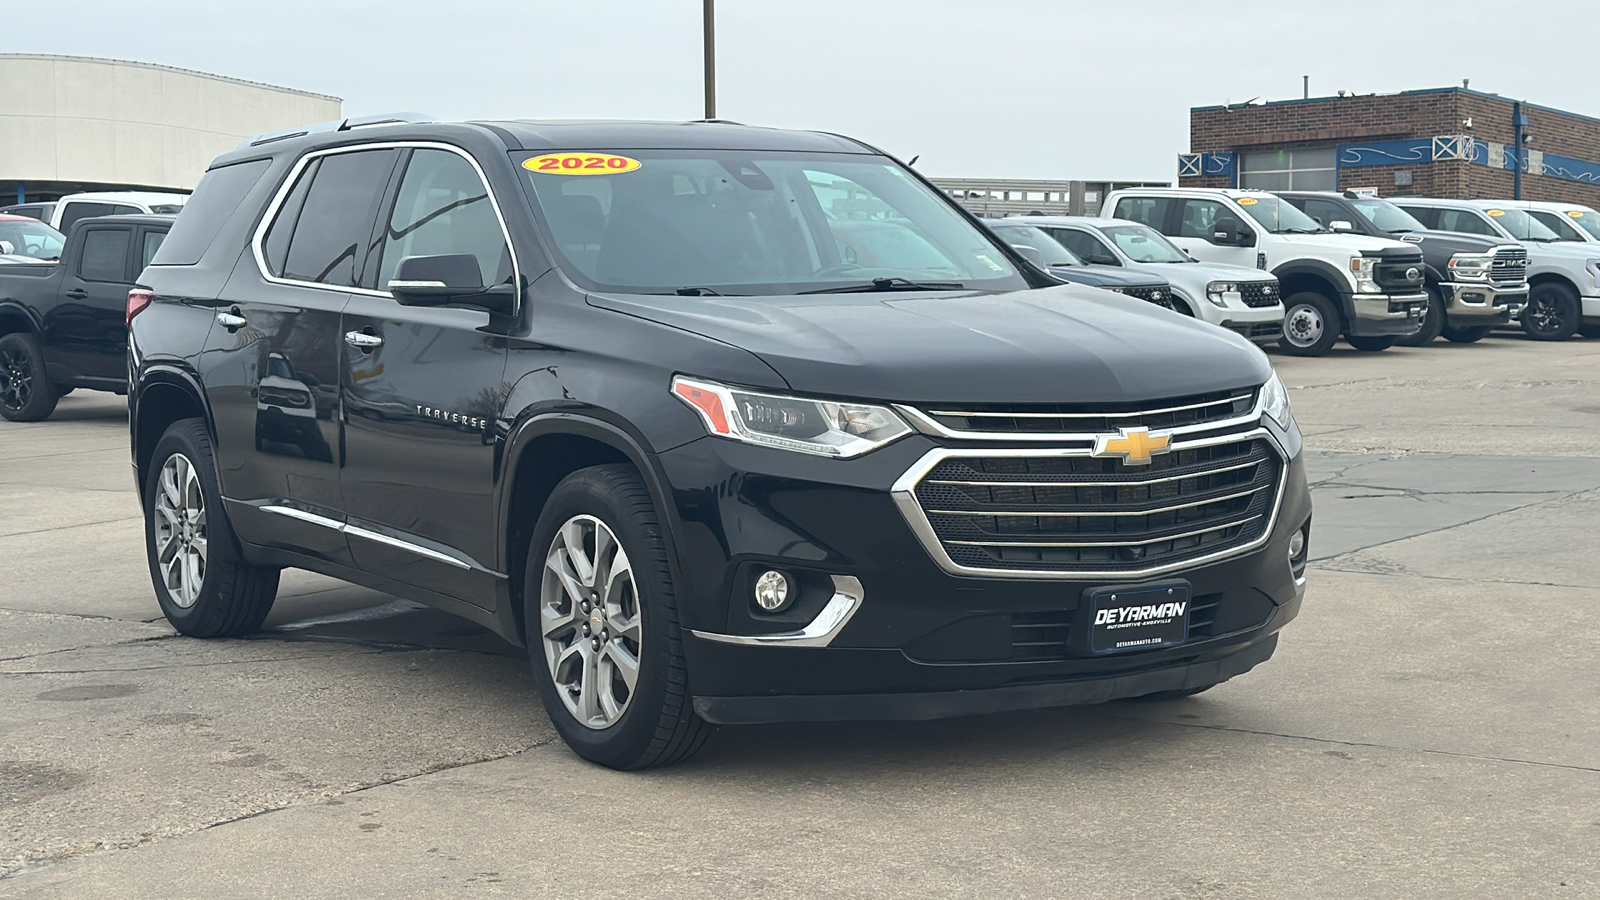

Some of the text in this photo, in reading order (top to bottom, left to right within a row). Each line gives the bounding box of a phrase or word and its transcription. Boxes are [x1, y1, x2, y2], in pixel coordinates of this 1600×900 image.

[538, 157, 628, 170] 2020
[416, 405, 486, 430] TRAVERSE
[1094, 601, 1187, 625] DEYARMAN
